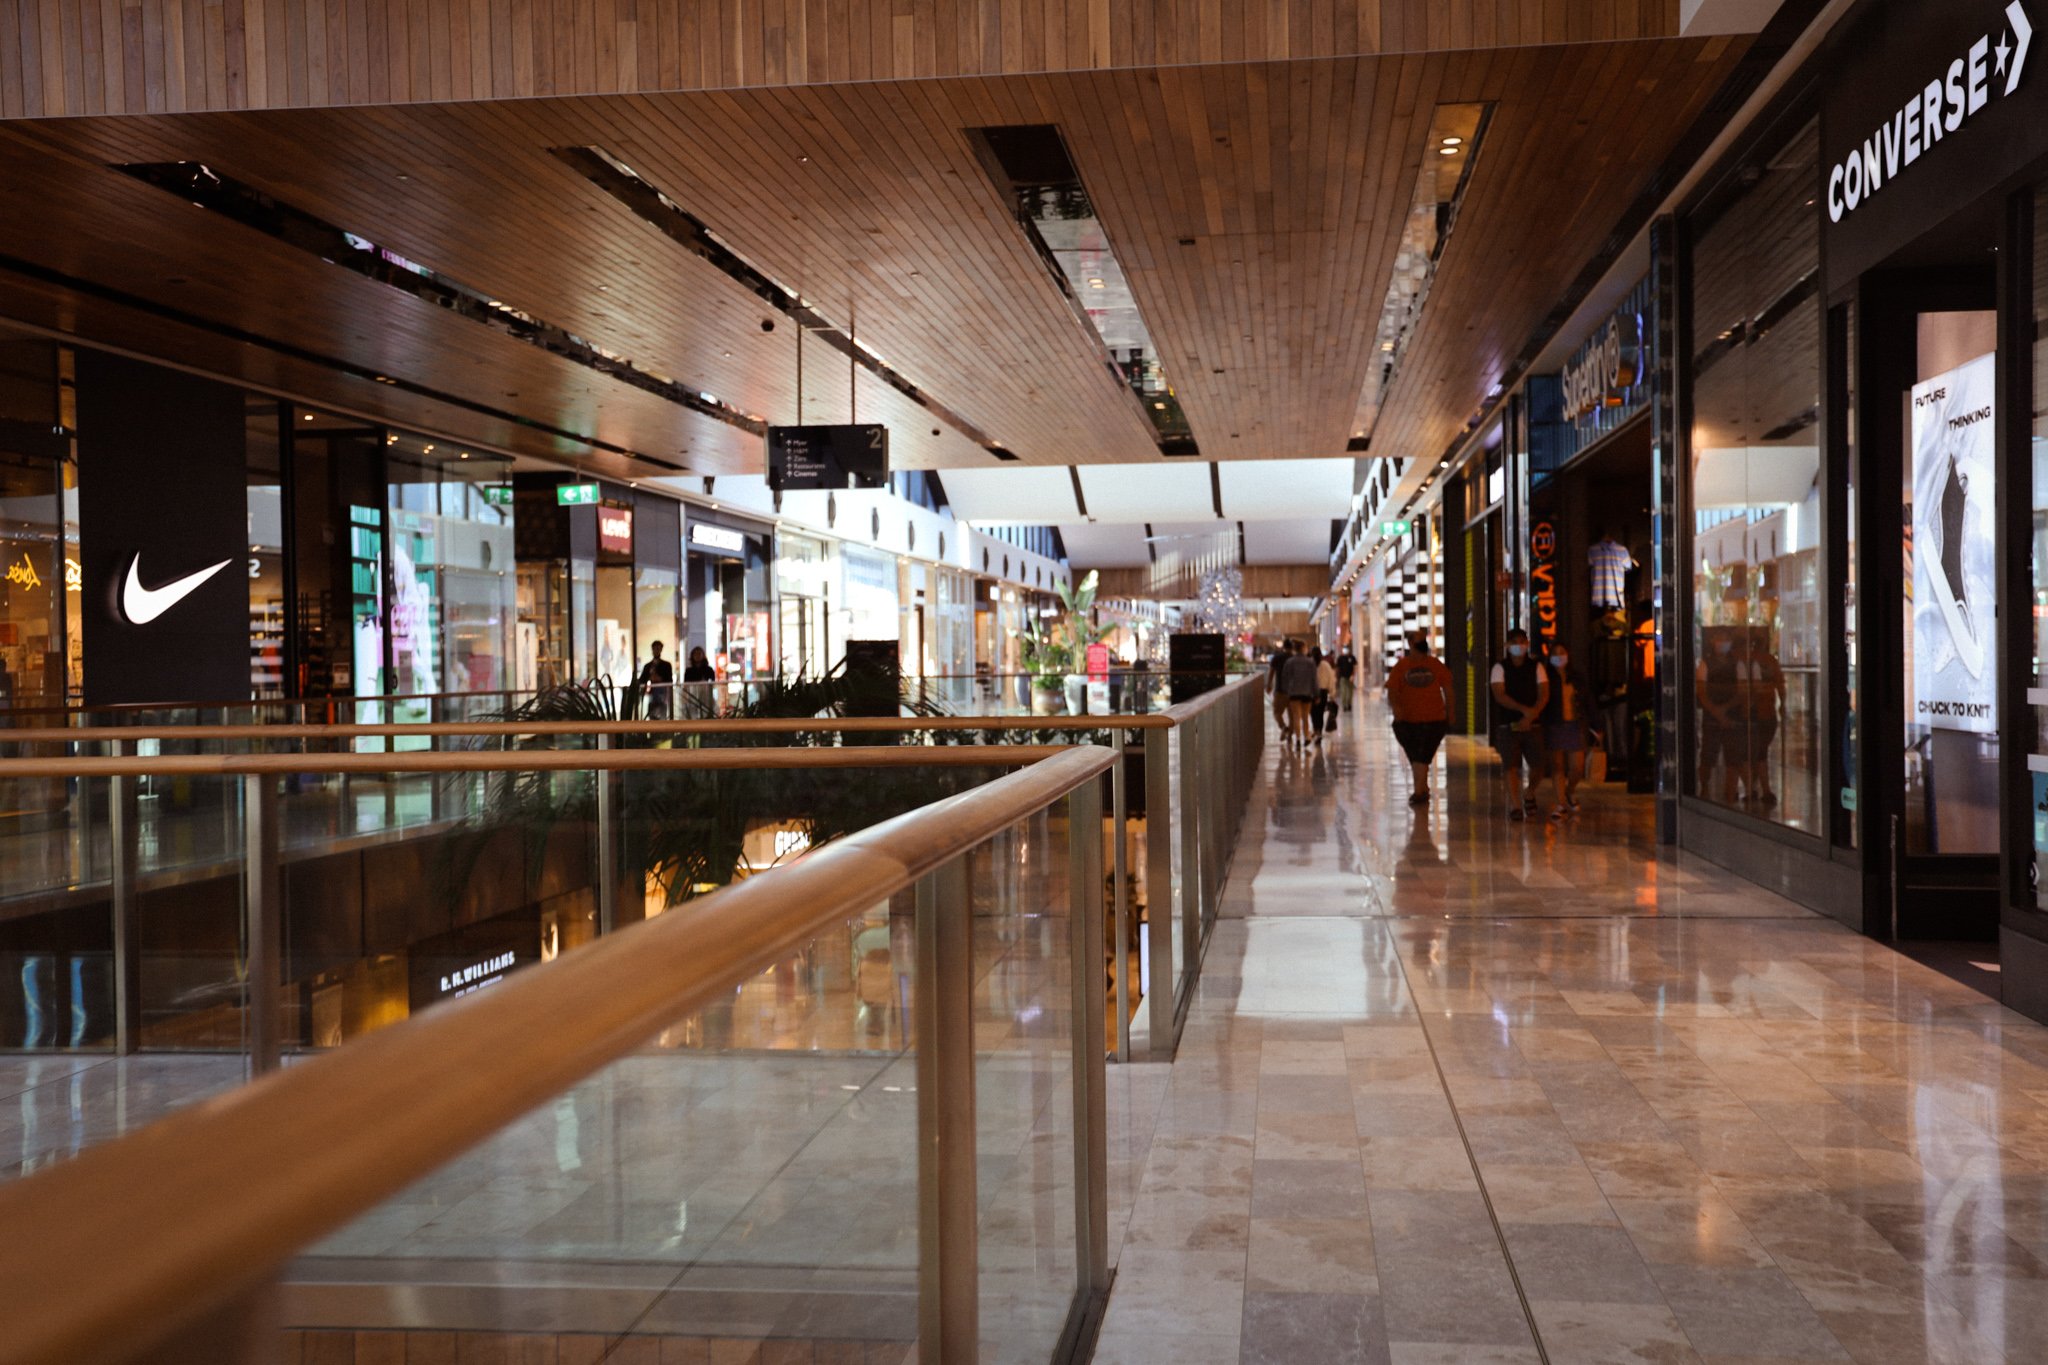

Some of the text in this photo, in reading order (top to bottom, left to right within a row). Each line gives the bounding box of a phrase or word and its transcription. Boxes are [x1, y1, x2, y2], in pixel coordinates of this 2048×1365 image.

[1828, 34, 1988, 223] CONVERSE
[1915, 387, 1946, 409] FUTURE
[1948, 405, 1991, 431] THINKING
[869, 428, 882, 449] 2
[1918, 700, 1991, 719] CHUCK 70 KNIT
